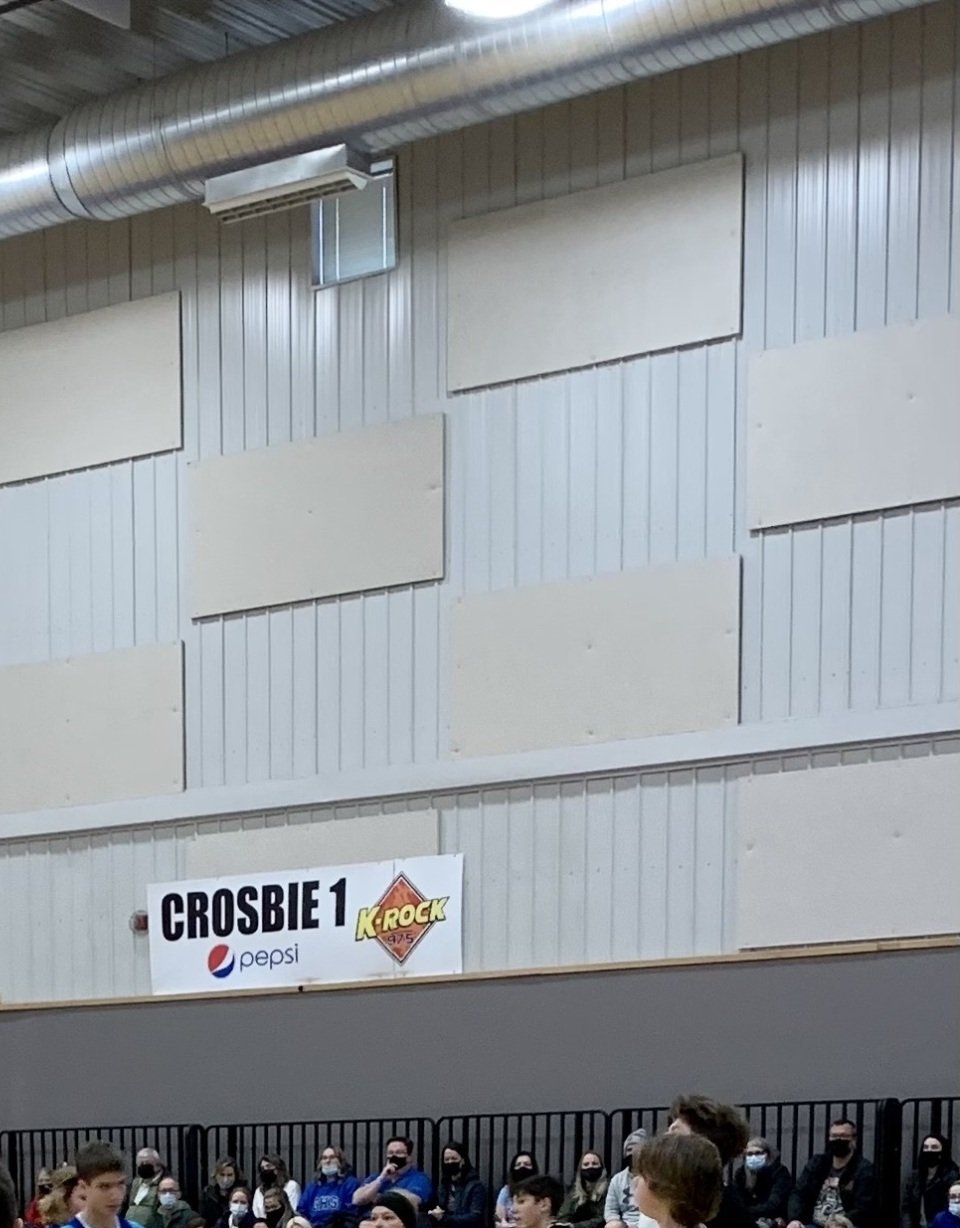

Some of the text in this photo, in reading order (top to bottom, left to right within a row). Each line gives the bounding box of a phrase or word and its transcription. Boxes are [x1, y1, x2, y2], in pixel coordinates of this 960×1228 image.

[161, 877, 346, 942] CROSBIE 1
[355, 896, 450, 942] K-ROCK
[239, 943, 300, 973] pepsi
